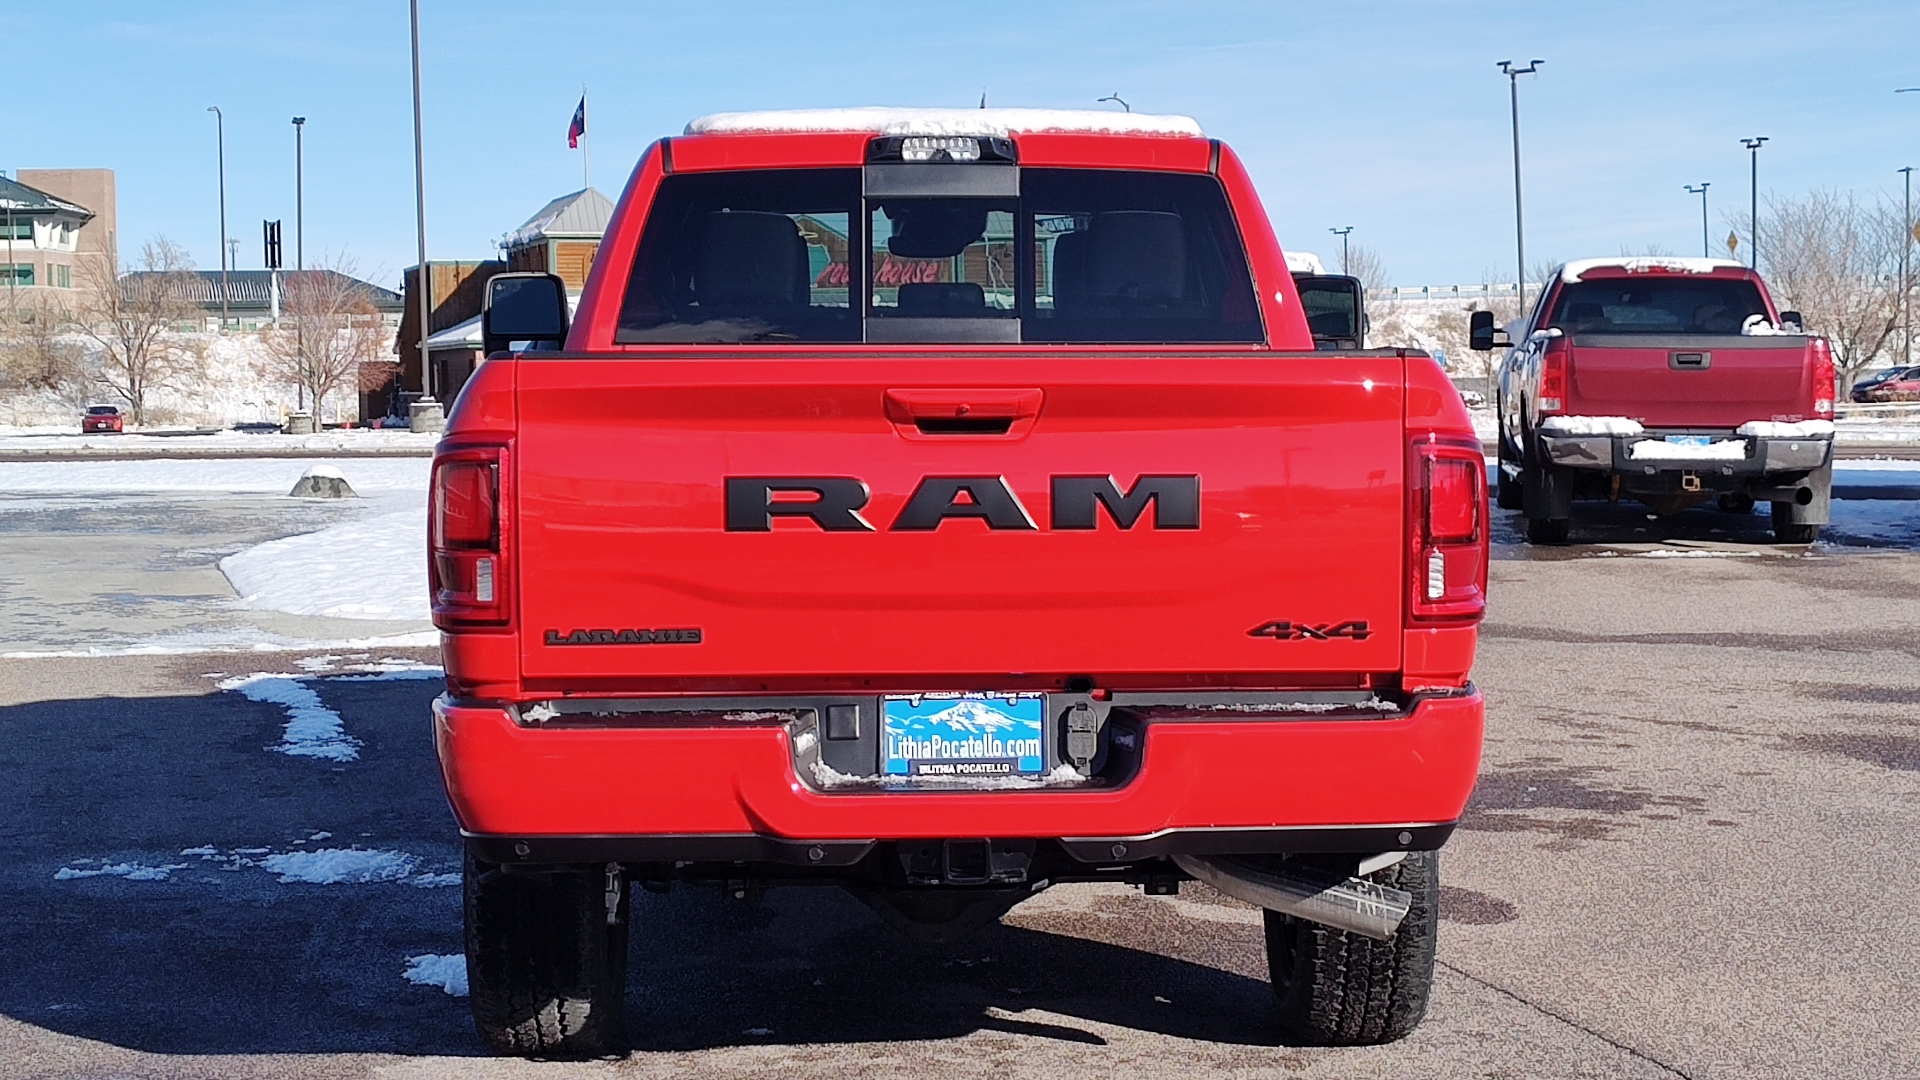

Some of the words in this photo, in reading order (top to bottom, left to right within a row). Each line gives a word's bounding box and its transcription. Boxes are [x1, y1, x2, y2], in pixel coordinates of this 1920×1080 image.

[874, 256, 938, 284] house
[724, 475, 1201, 532] RAM
[544, 629, 702, 645] LARAMIE
[888, 734, 1040, 759] LithiaPocatello.com
[957, 763, 1010, 774] POCATELLO
